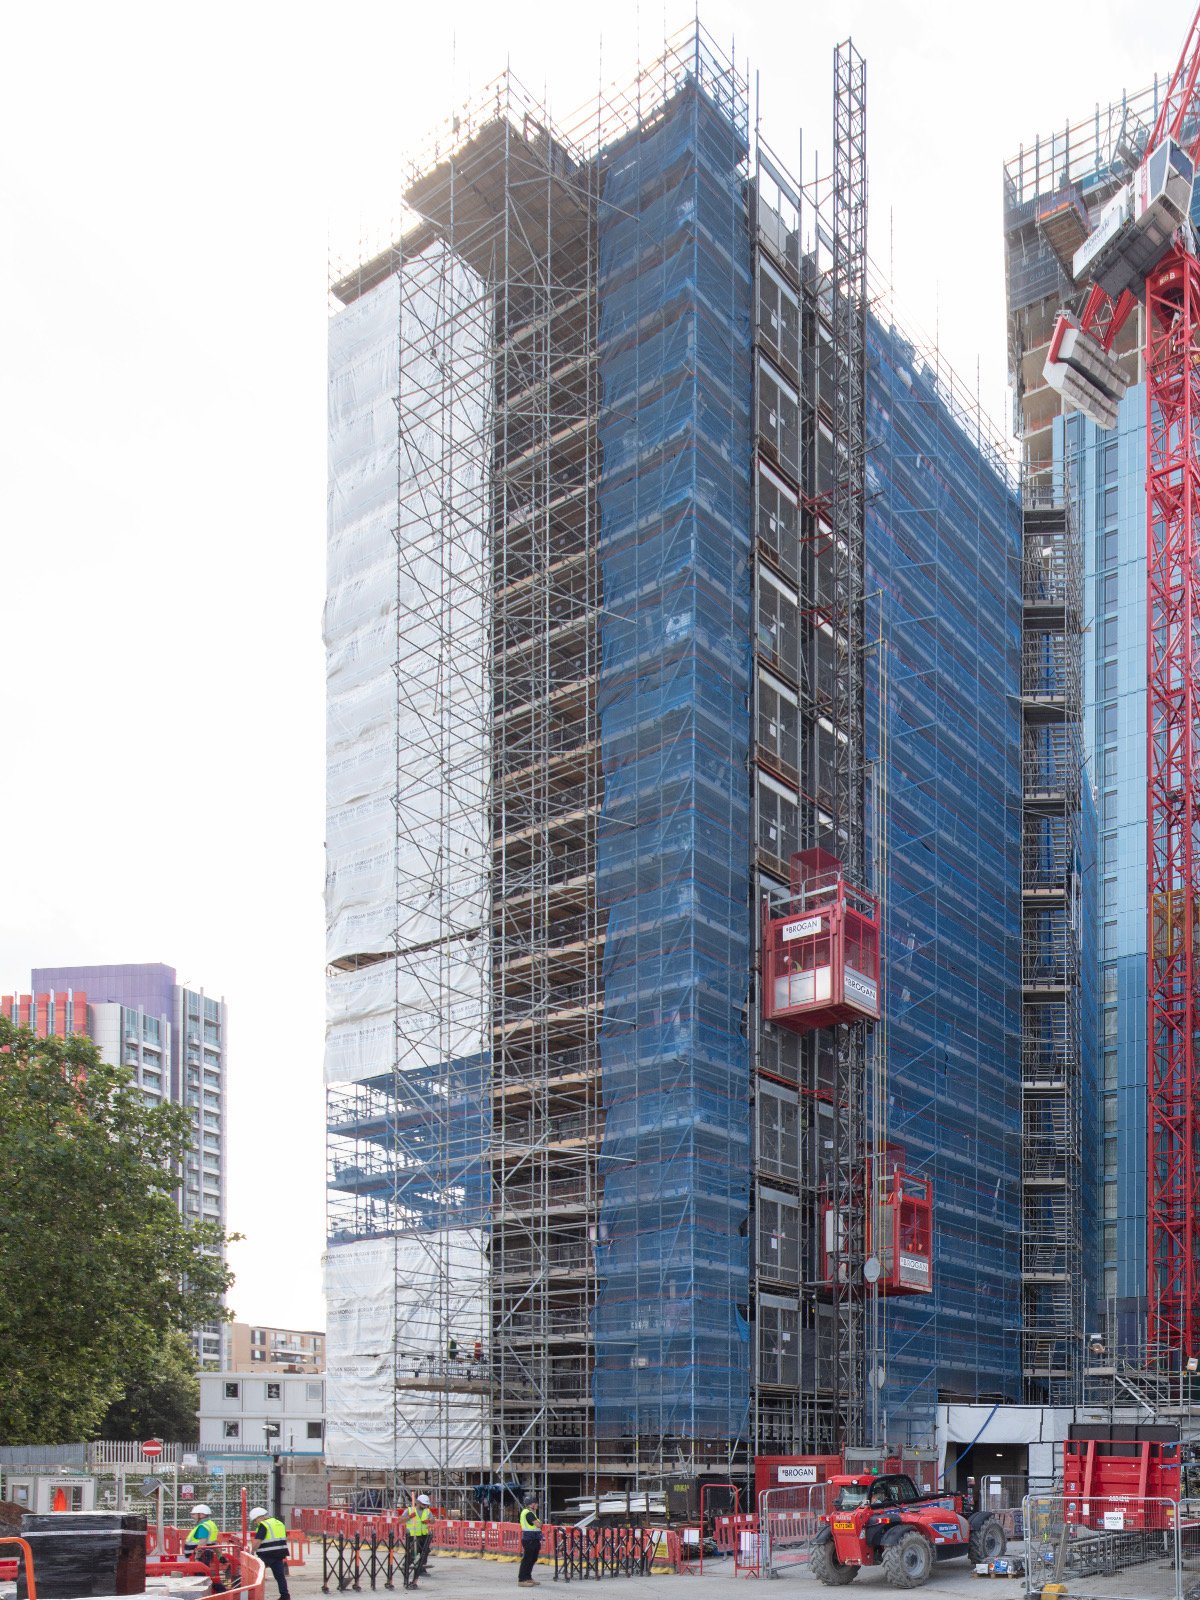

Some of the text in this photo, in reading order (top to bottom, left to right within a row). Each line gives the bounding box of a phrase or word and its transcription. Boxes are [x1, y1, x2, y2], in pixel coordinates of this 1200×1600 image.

[788, 920, 818, 934] BROGAN
[847, 977, 876, 999] BROGAN
[903, 1258, 928, 1271] BROGAN
[784, 1468, 814, 1477] BROGAN
